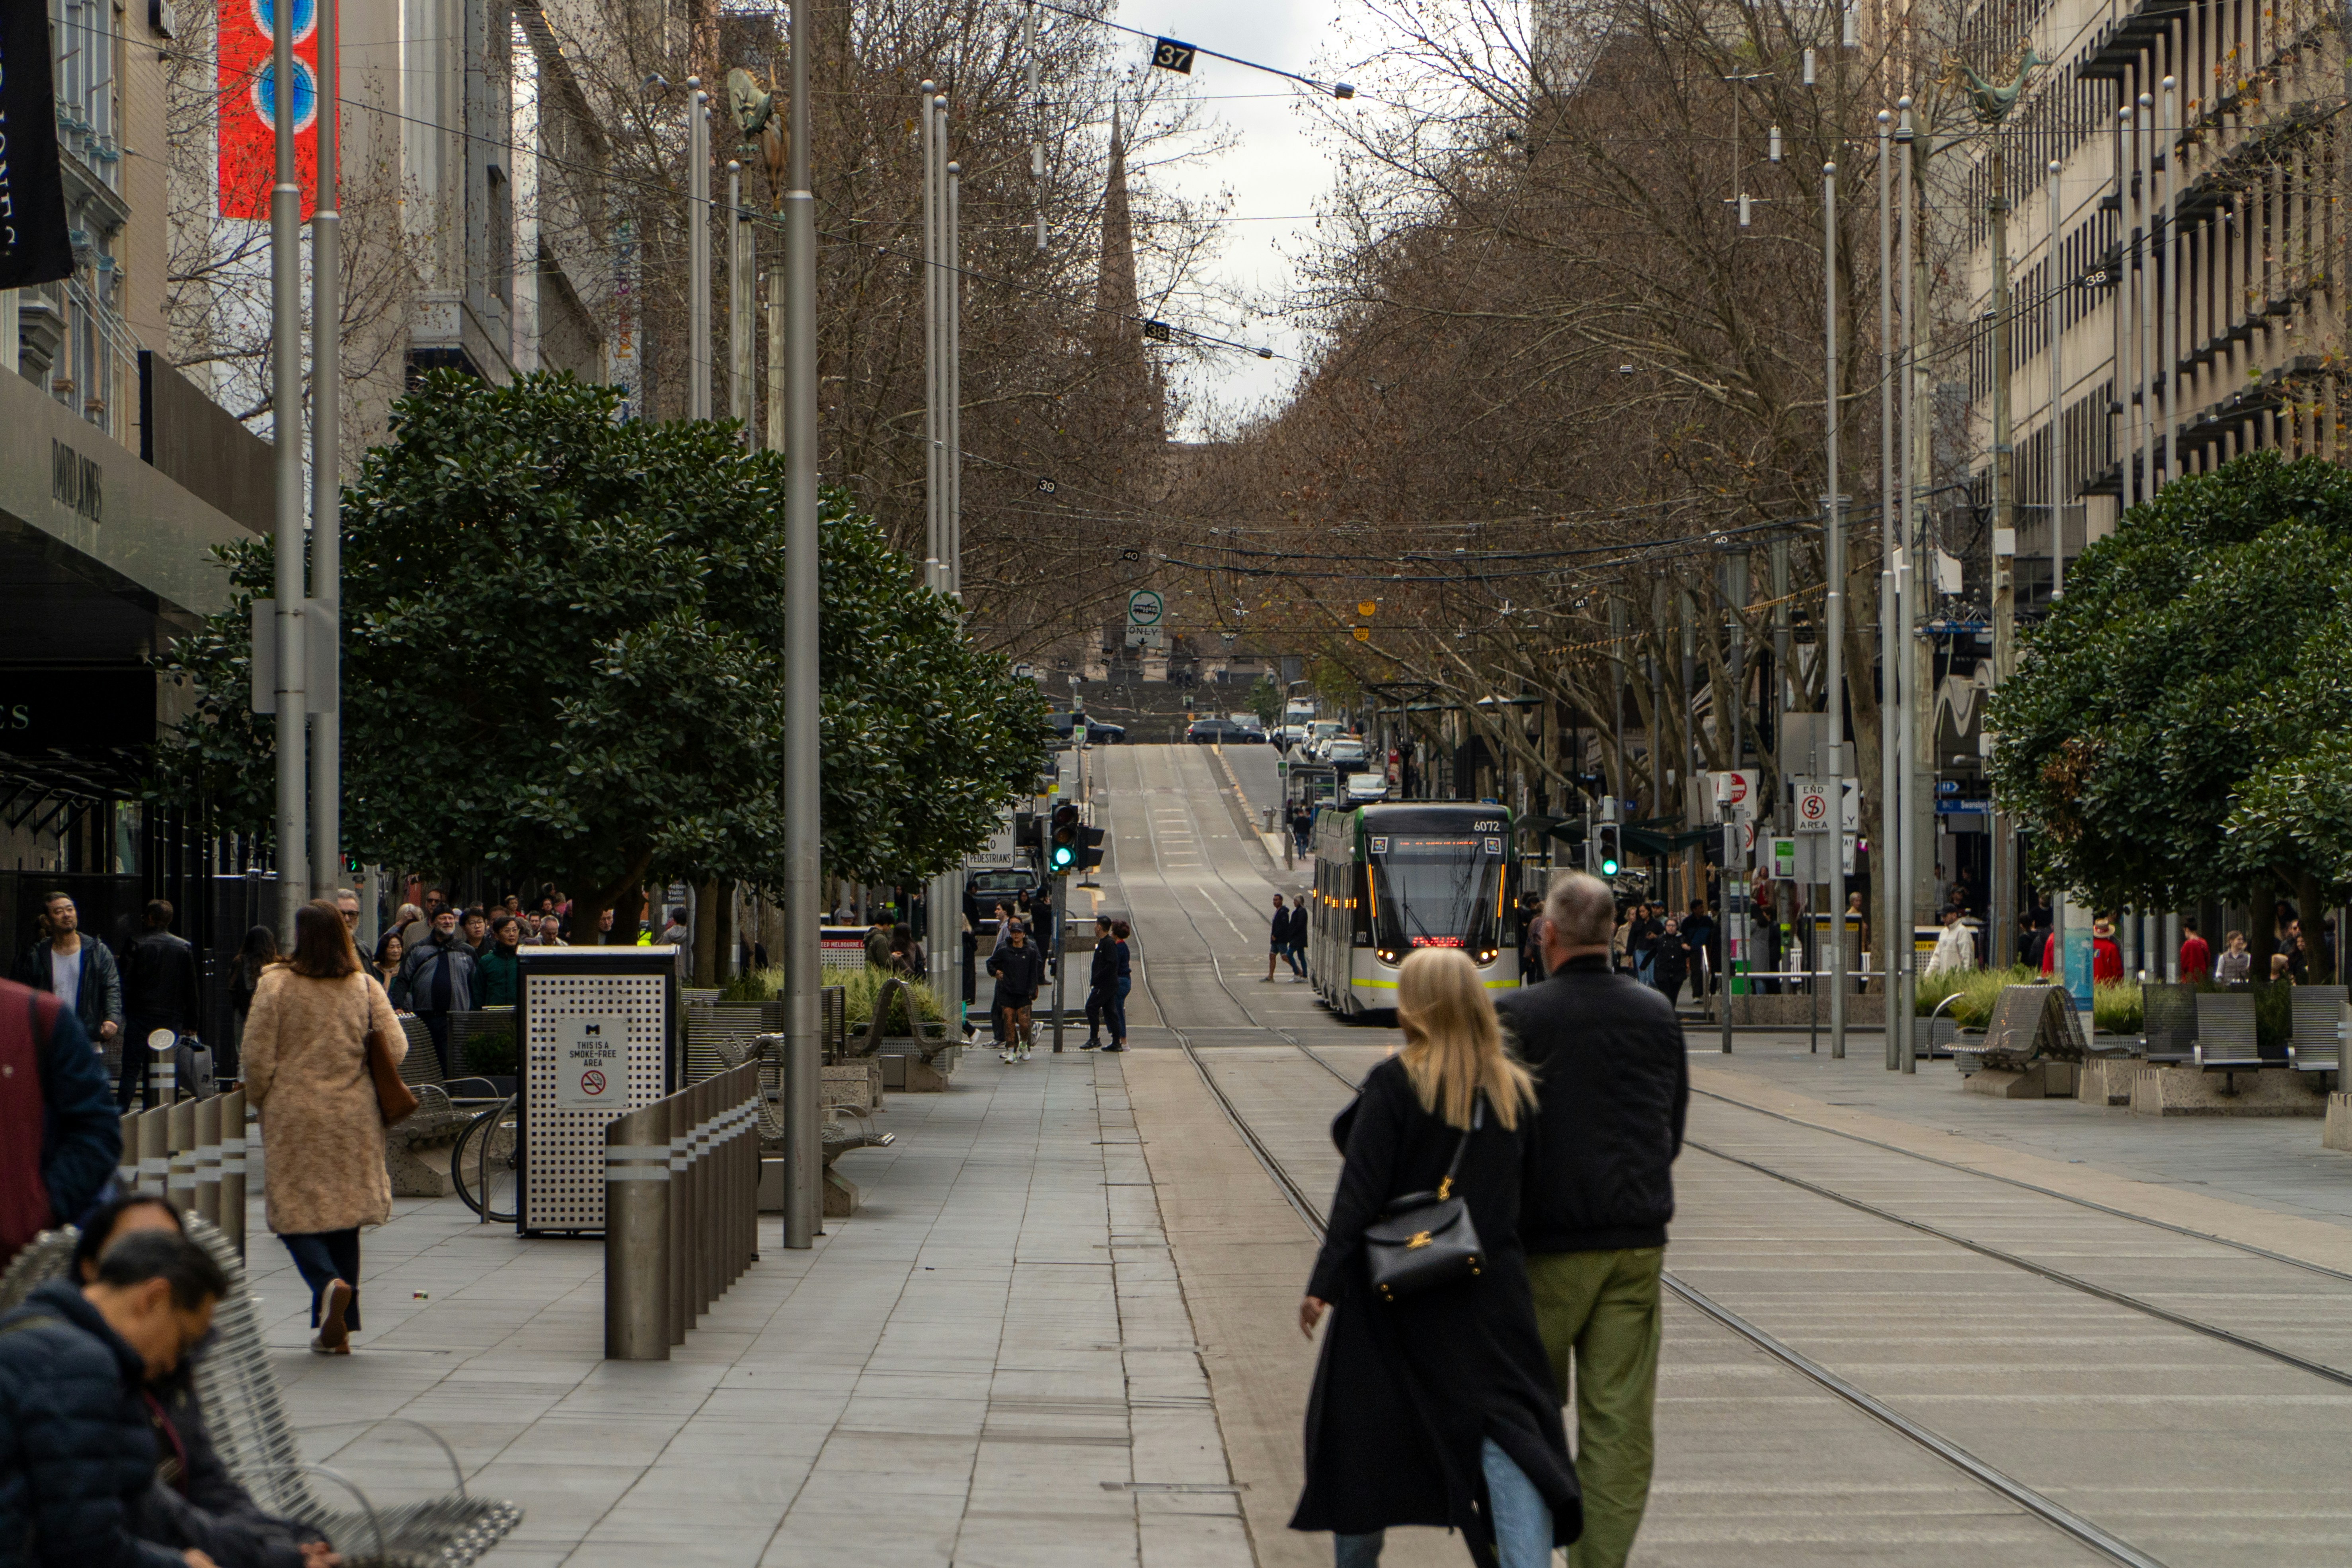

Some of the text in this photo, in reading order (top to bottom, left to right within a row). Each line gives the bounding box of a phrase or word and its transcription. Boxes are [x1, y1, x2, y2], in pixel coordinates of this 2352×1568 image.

[1158, 45, 1190, 67] 37
[2086, 271, 2106, 286] 38
[1148, 324, 1167, 339] 38
[1039, 480, 1055, 492] 39
[1124, 552, 1138, 561] 40
[1129, 626, 1158, 636] ONLY
[1474, 821, 1500, 831] 6072
[970, 853, 1011, 863] PEDESTRIANS
[569, 1050, 616, 1058] SMOKE-FREE
[583, 1059, 603, 1067] AREA
